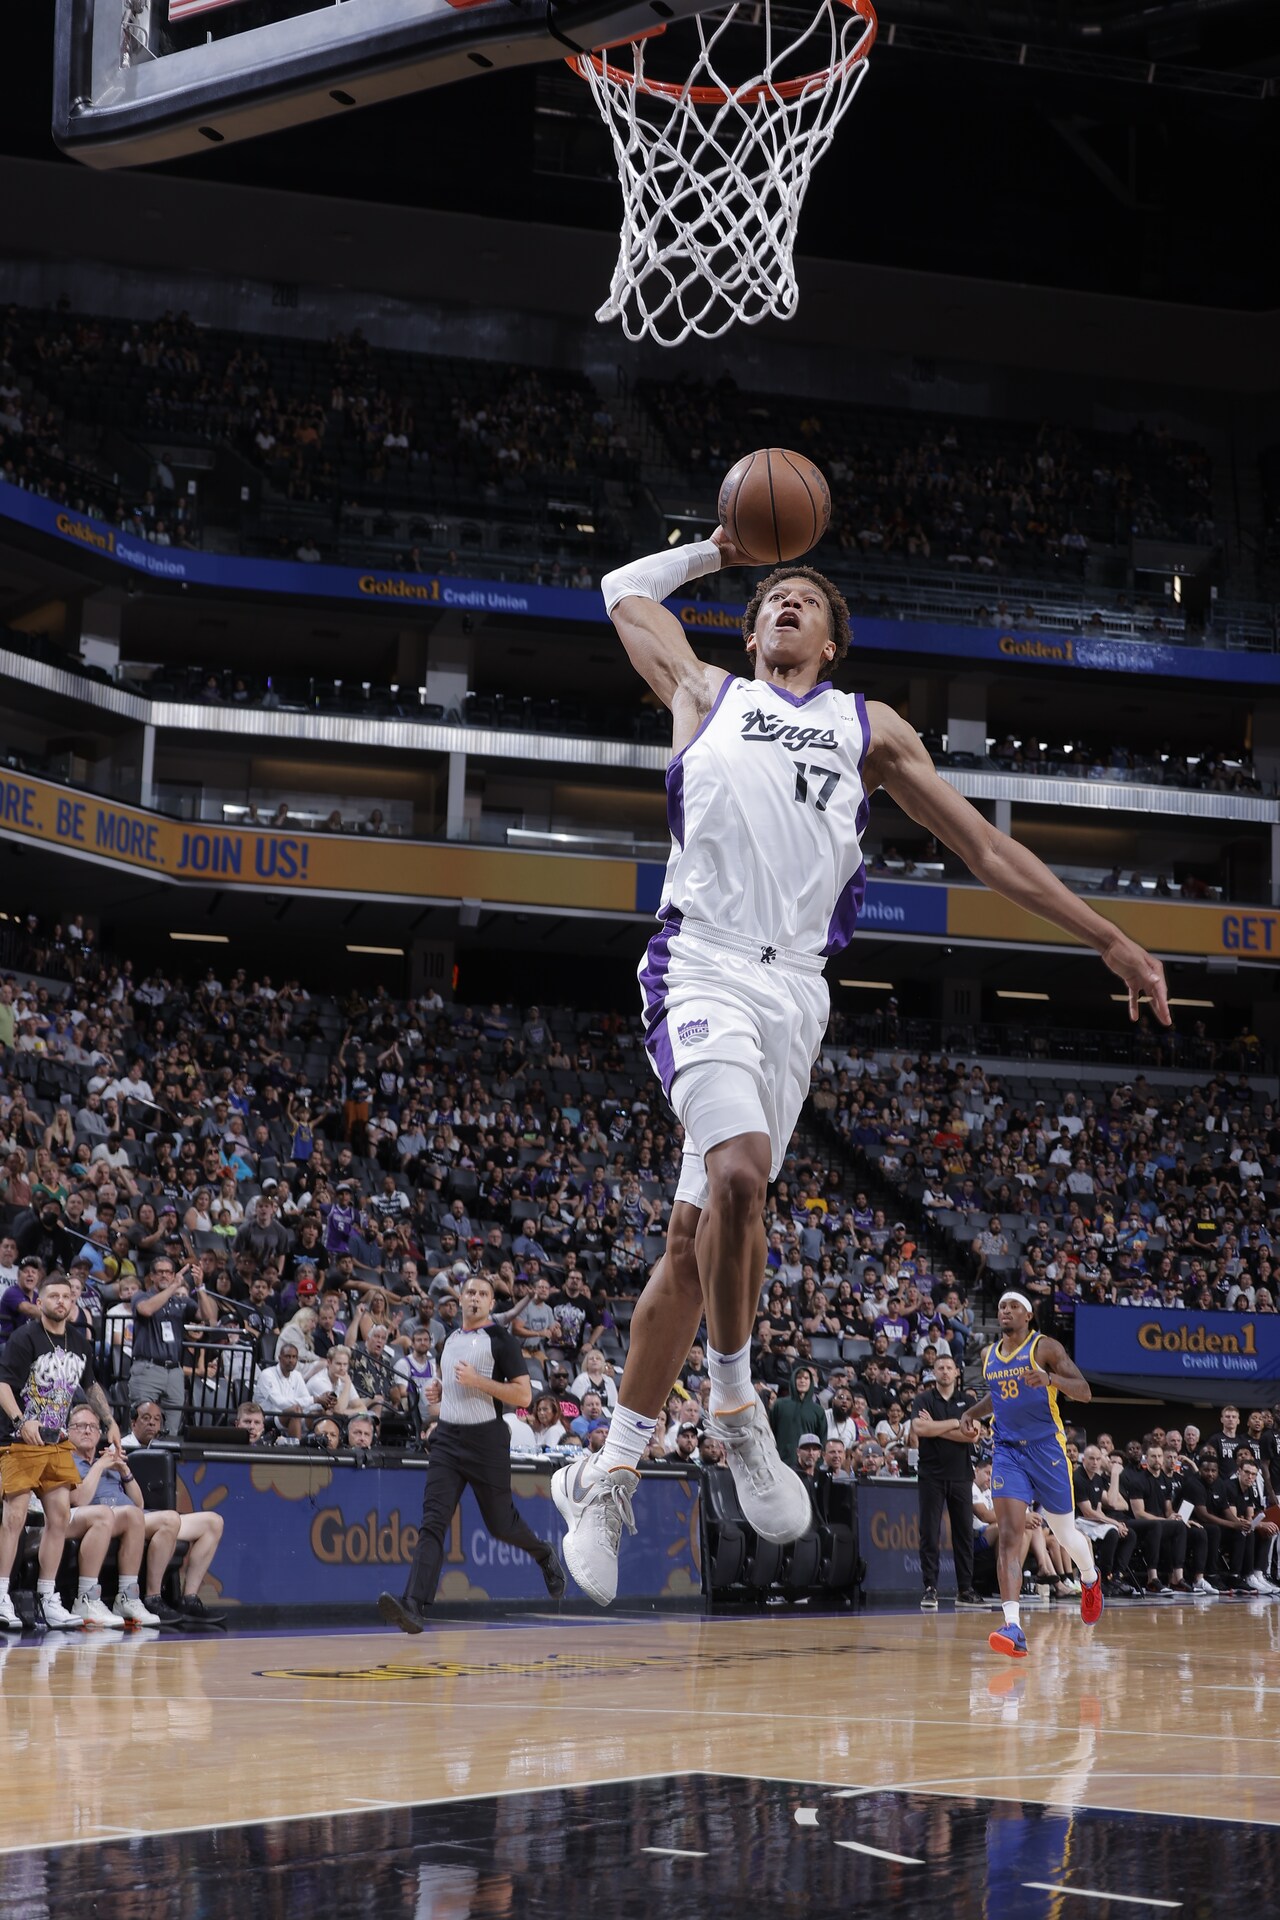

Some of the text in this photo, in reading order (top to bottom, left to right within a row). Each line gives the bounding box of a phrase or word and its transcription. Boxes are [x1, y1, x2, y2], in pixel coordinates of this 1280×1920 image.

[147, 556, 186, 575] Union
[443, 588, 486, 606] Credit
[488, 592, 528, 610] Union
[741, 708, 839, 752] Kings
[793, 761, 842, 812] 17
[56, 797, 87, 842] BE
[96, 809, 165, 865] MORE.
[176, 832, 243, 875] JOIN
[254, 837, 309, 880] US!
[1222, 914, 1278, 952] GET
[1181, 1353, 1258, 1371] Credit Union
[998, 1379, 1019, 1400] 38
